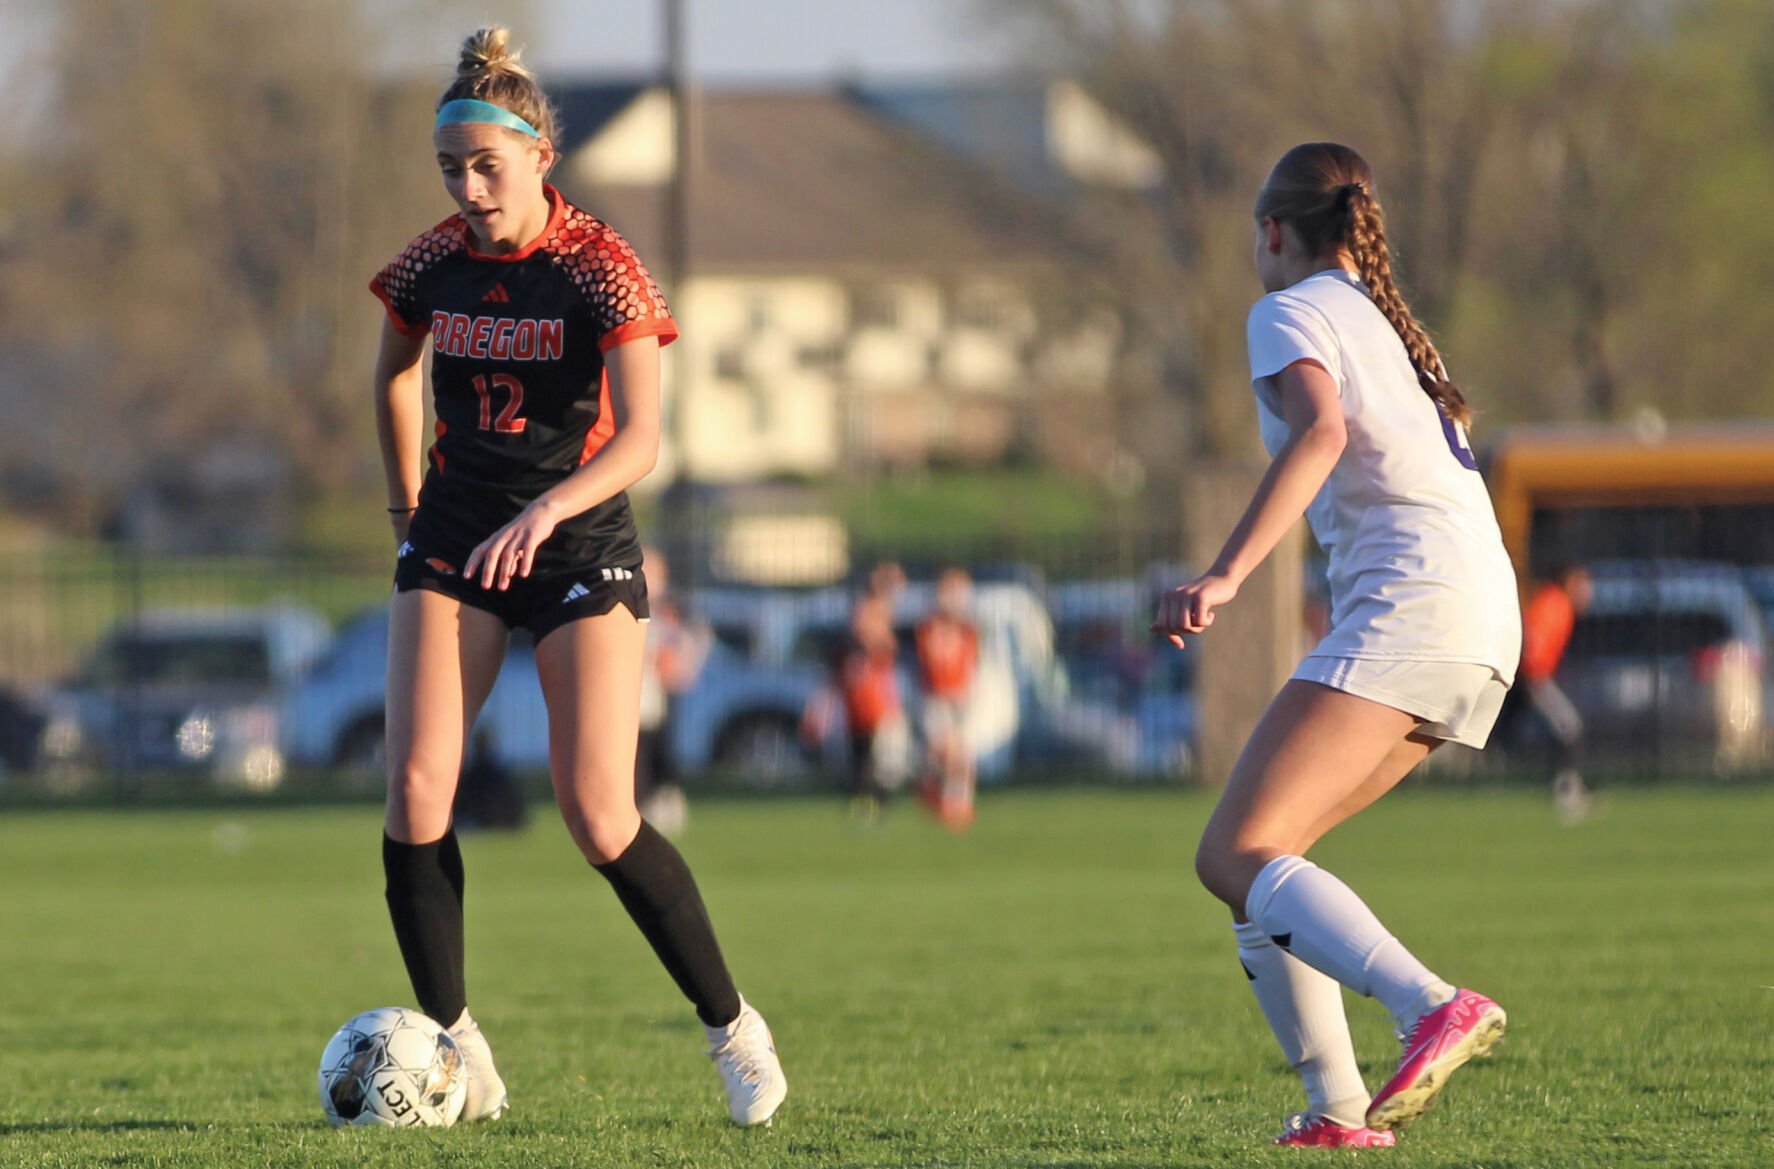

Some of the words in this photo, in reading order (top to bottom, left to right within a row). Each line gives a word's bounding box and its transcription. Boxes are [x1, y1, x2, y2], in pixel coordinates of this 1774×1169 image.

[432, 310, 564, 361] OREGON
[472, 372, 528, 434] 12
[376, 1080, 428, 1127] LECT
